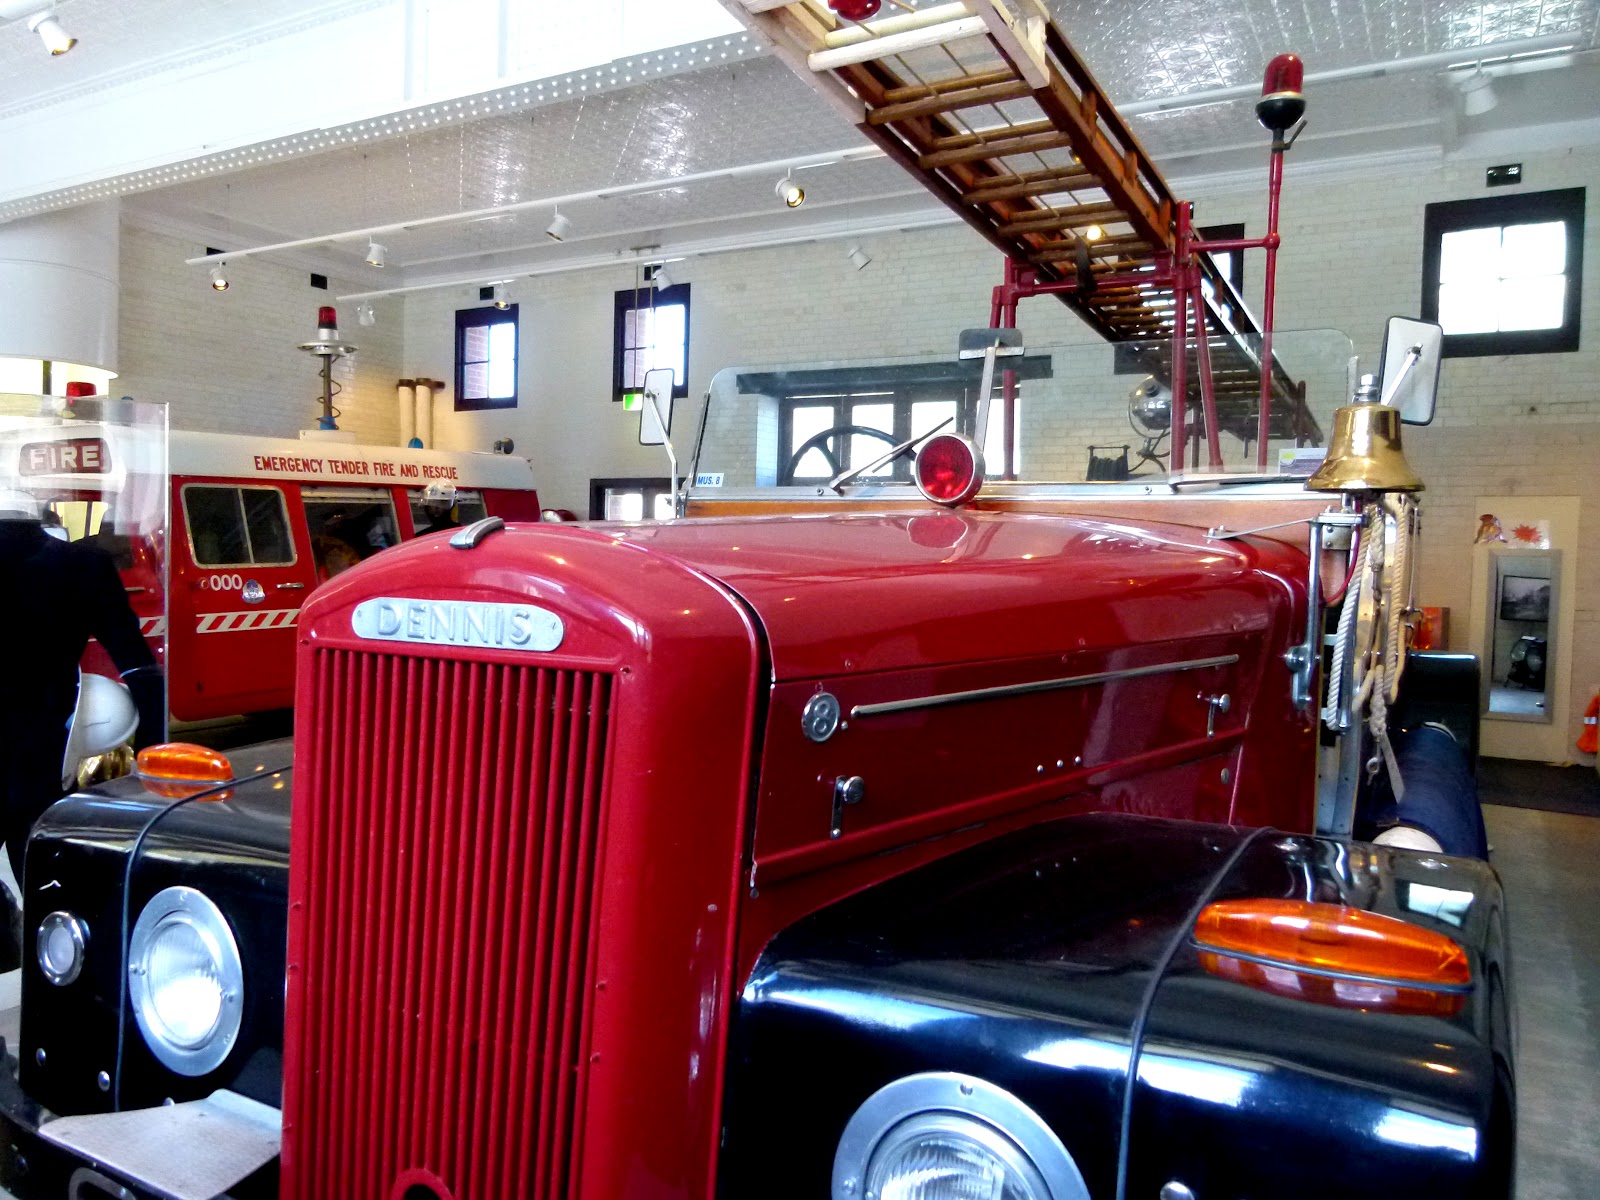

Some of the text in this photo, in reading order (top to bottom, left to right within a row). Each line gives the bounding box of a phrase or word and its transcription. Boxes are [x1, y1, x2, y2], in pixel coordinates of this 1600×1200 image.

[30, 445, 100, 470] FIRE
[254, 455, 459, 480] EMERGENCY TENDER FIRE AND RESCUE
[697, 476, 714, 485] MUS.
[210, 573, 243, 591] 000
[377, 600, 533, 646] DENNIS
[812, 700, 831, 735] 8
